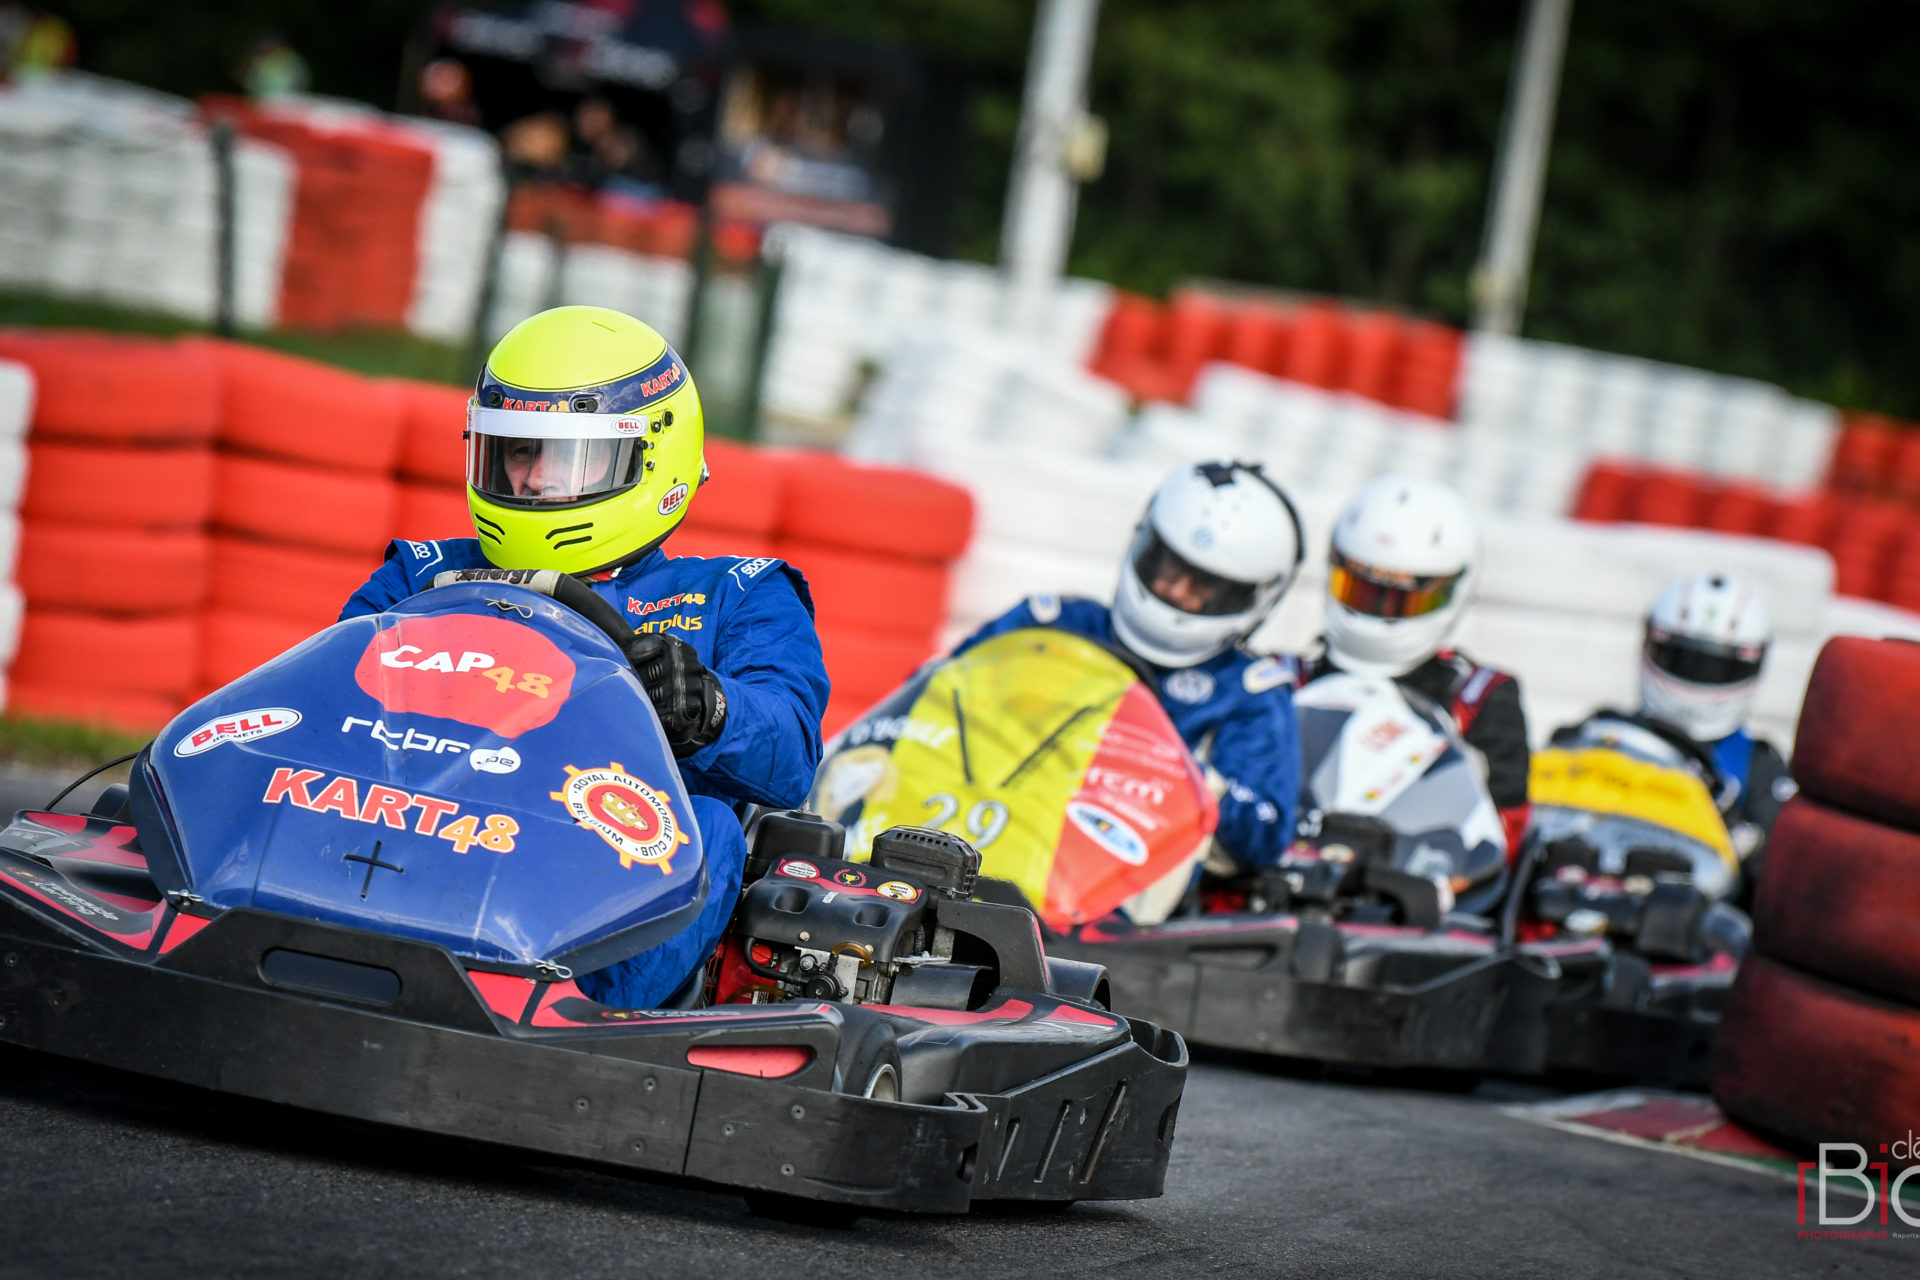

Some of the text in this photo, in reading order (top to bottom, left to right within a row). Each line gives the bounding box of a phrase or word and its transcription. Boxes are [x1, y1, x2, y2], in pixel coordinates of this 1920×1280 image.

[640, 362, 681, 397] KART48
[618, 421, 639, 429] BELL
[662, 487, 685, 510] BELL
[627, 593, 706, 616] KART48
[380, 645, 553, 698] CAP48
[191, 714, 283, 747] BELL
[213, 729, 263, 742] HEMETS
[263, 767, 519, 854] KART48
[573, 773, 673, 857] ROYAL AUTOMOBILE CLUB
[922, 792, 1009, 850] 29
